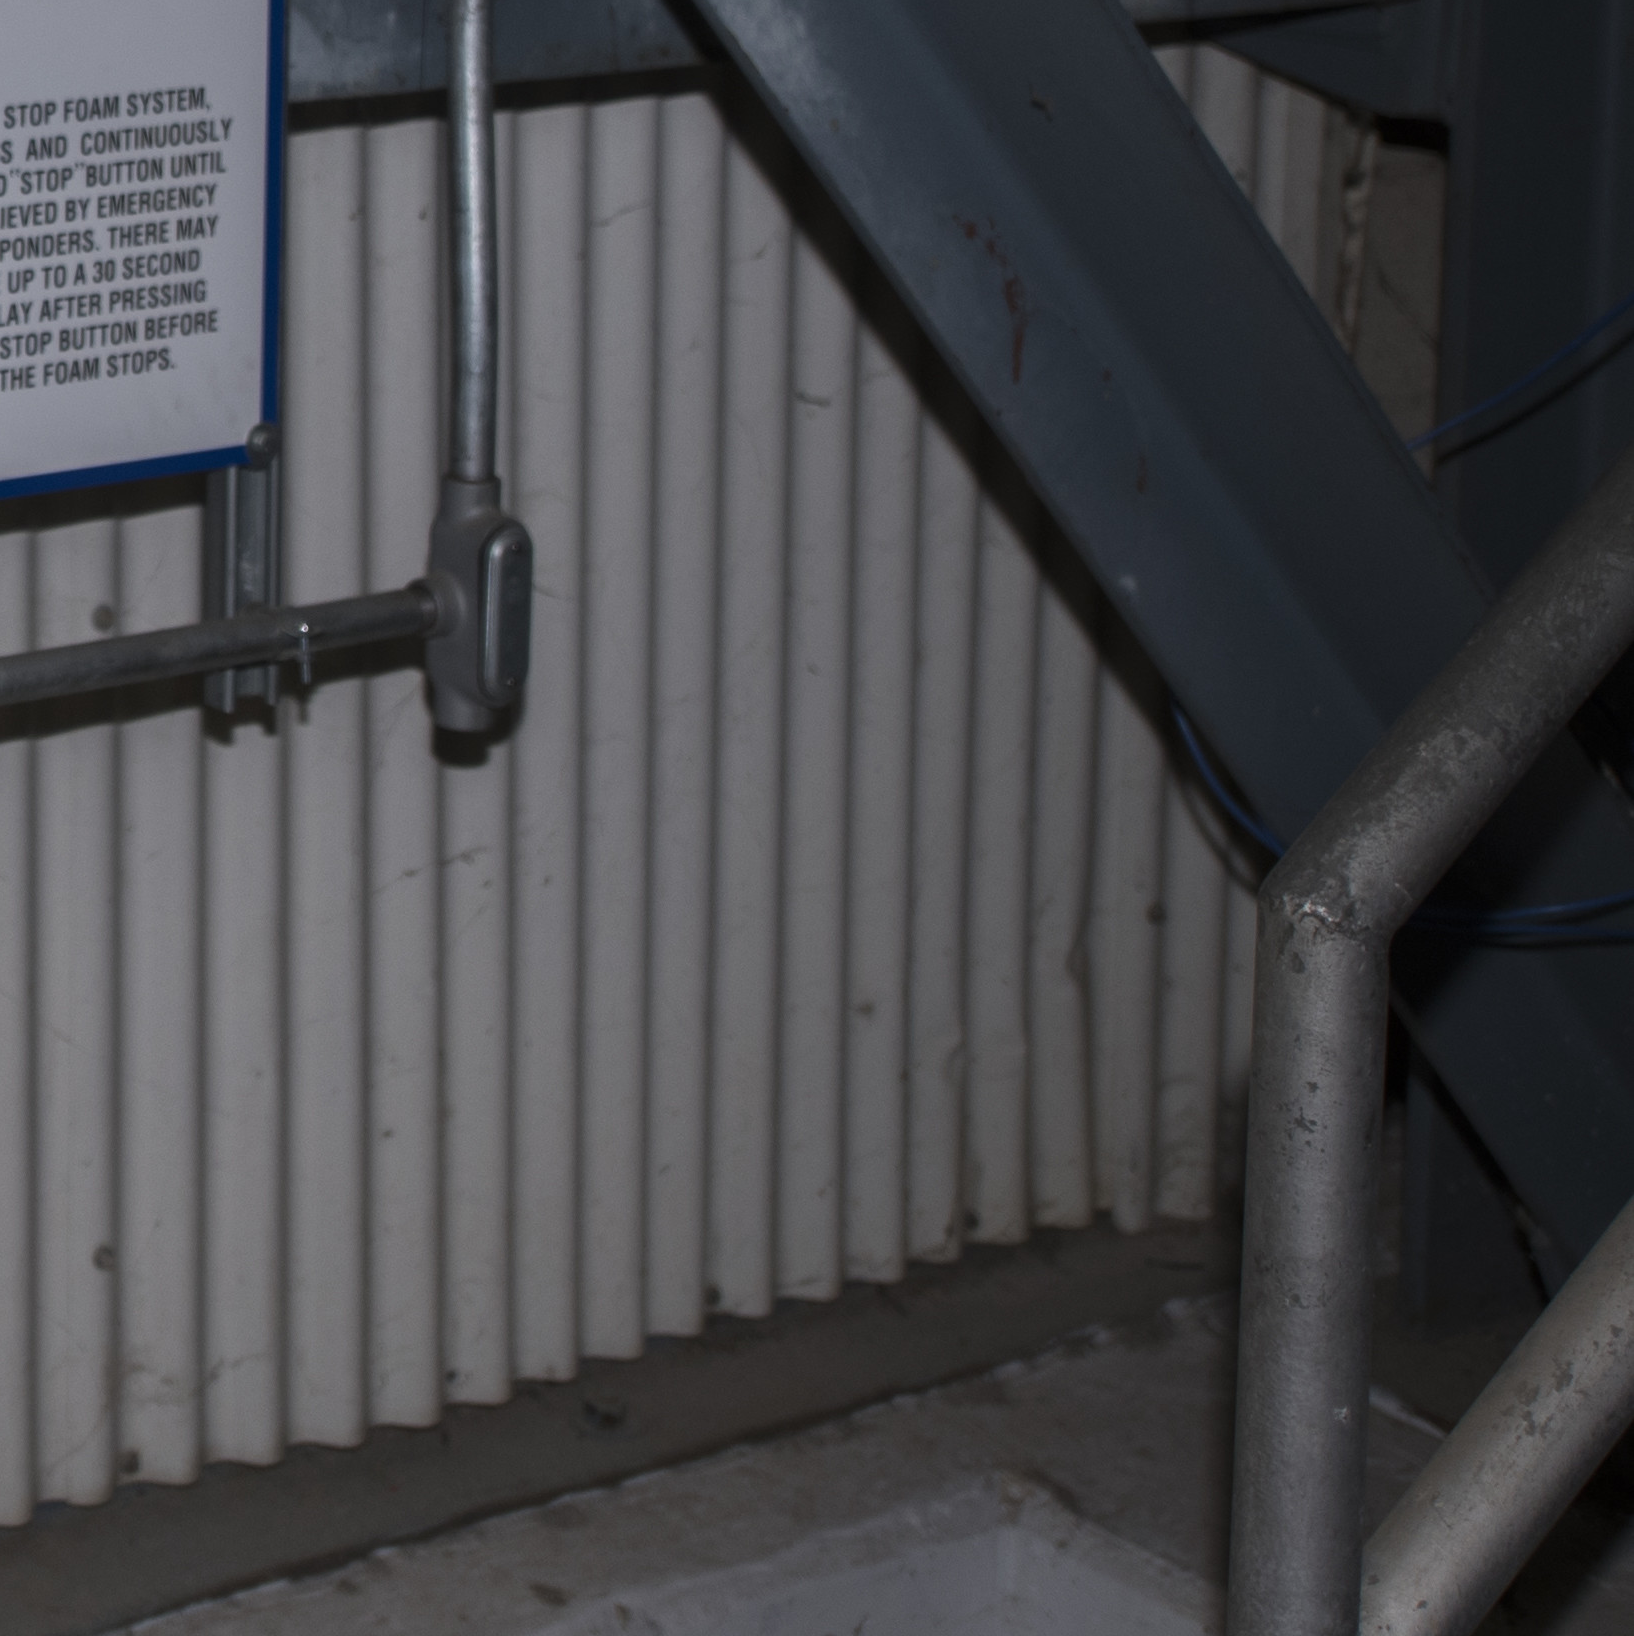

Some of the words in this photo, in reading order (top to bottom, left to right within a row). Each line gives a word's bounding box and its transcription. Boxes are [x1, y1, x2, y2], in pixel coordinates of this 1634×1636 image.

[4, 102, 56, 129] STOP
[63, 96, 119, 123] FOAM
[127, 87, 210, 117] SYSTEM,
[26, 136, 68, 162] AND
[81, 118, 232, 156] CONTINUOUSLY
[86, 158, 163, 187] BUTTON
[170, 151, 226, 179] UNTIL
[65, 198, 90, 222] BY
[97, 183, 217, 218] EMERGENCY
[107, 221, 169, 249] THERE
[176, 215, 218, 241] MAY
[7, 268, 35, 294] UP
[41, 265, 67, 289] TO
[73, 263, 87, 286] A
[92, 259, 116, 284] 30
[122, 249, 201, 280] SECOND
[39, 293, 102, 322] AFTER
[109, 279, 207, 313] PRESSING
[0, 331, 52, 360] STOP
[59, 321, 137, 352] BUTTON
[144, 310, 218, 341] BEFORE
[43, 357, 100, 386] FOAM
[106, 347, 175, 378] STOPS.
